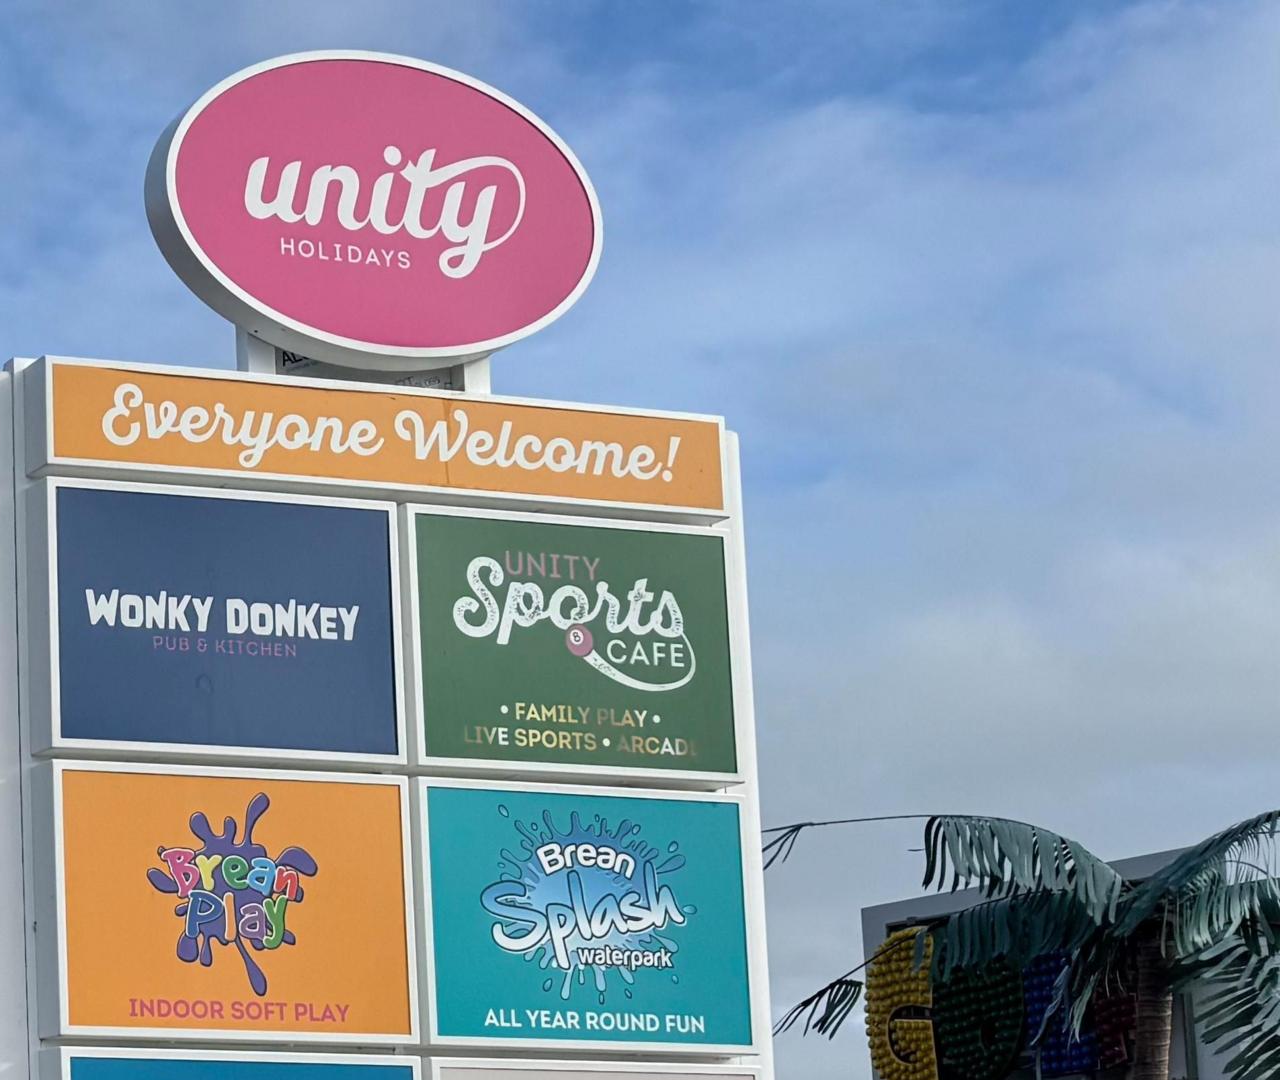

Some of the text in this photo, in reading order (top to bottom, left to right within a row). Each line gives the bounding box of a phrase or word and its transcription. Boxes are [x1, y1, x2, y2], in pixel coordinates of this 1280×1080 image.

[244, 146, 526, 278] unity
[281, 237, 411, 269] HOLIDAYS
[102, 383, 681, 483] Everyone Welcome!
[505, 550, 600, 581] UNITY
[85, 588, 360, 641] WONKY DONKEY
[452, 556, 685, 645] Sports
[152, 636, 297, 657] PUB & KITCHEN
[606, 639, 686, 667] CAFE
[515, 702, 648, 728] FAMILY PLAY
[464, 725, 509, 745] LIVE
[514, 728, 597, 751] SPORTS
[161, 847, 299, 902] Brean
[536, 842, 636, 880] Brean
[186, 889, 288, 951] Play
[480, 860, 687, 971] Splash
[577, 945, 673, 970] waterpark
[128, 998, 351, 1024] INDOOR SOFT PLAY
[484, 1008, 705, 1034] ALL YEAR ROUND FUN
